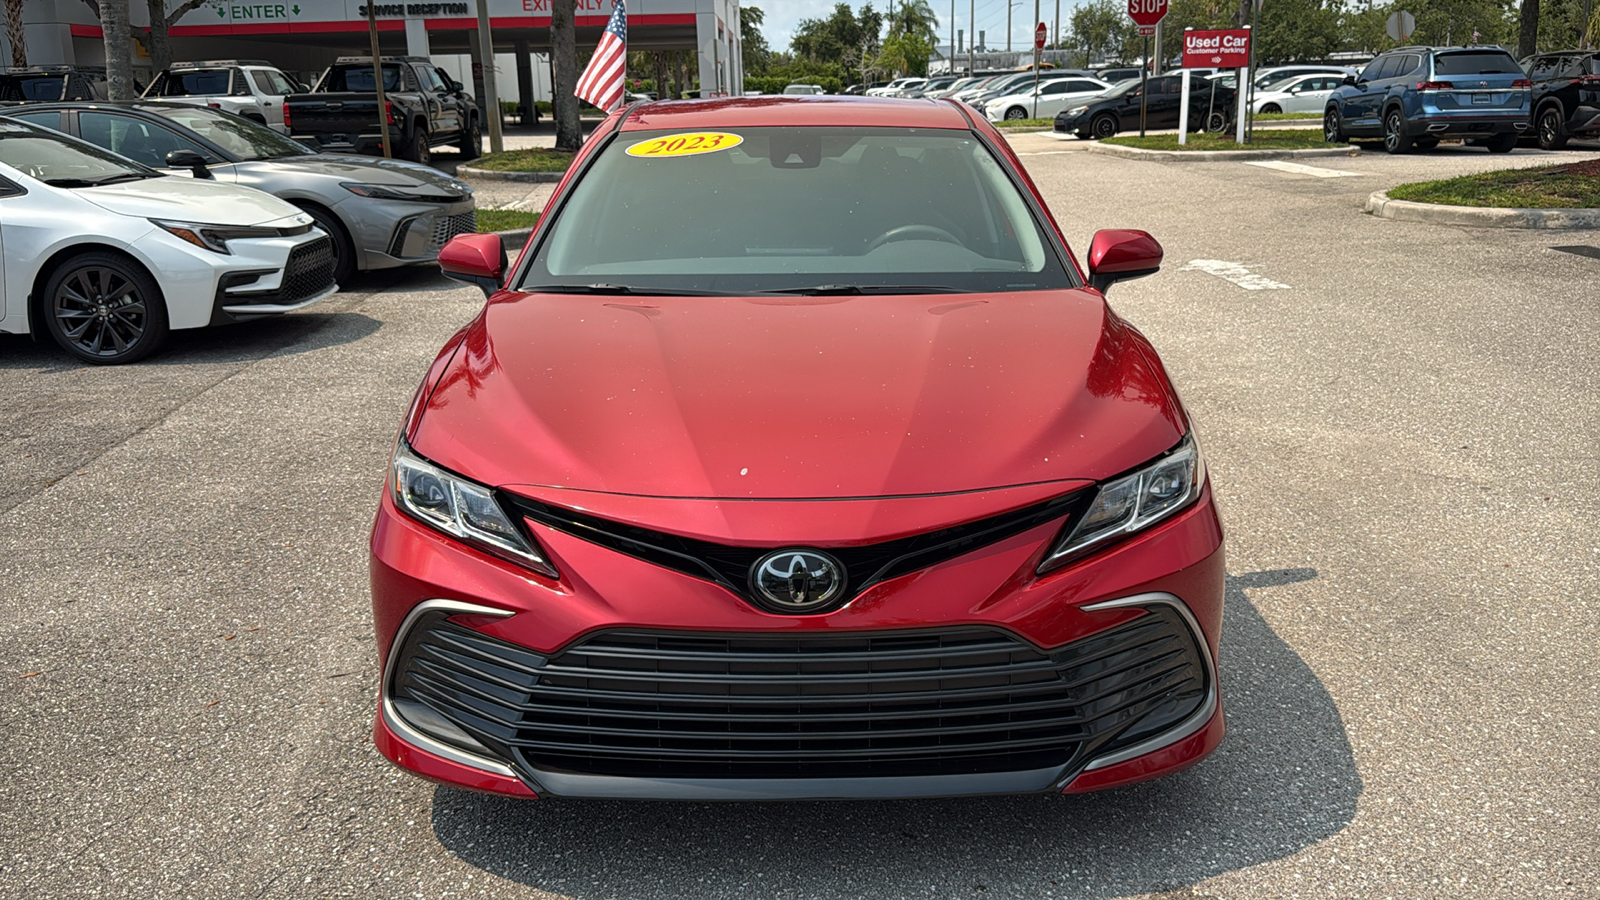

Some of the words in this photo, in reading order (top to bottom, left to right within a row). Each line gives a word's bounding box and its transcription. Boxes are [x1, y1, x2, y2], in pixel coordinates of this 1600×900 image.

[231, 4, 286, 19] ENTER
[358, 4, 405, 16] SRVICE
[407, 3, 468, 15] RECEPTION
[522, 0, 554, 11] EXIT
[573, 0, 602, 10] NLY
[1130, 0, 1166, 13] STOP
[1186, 36, 1220, 48] Used
[1223, 35, 1247, 47] Car
[645, 135, 724, 154] 2023
